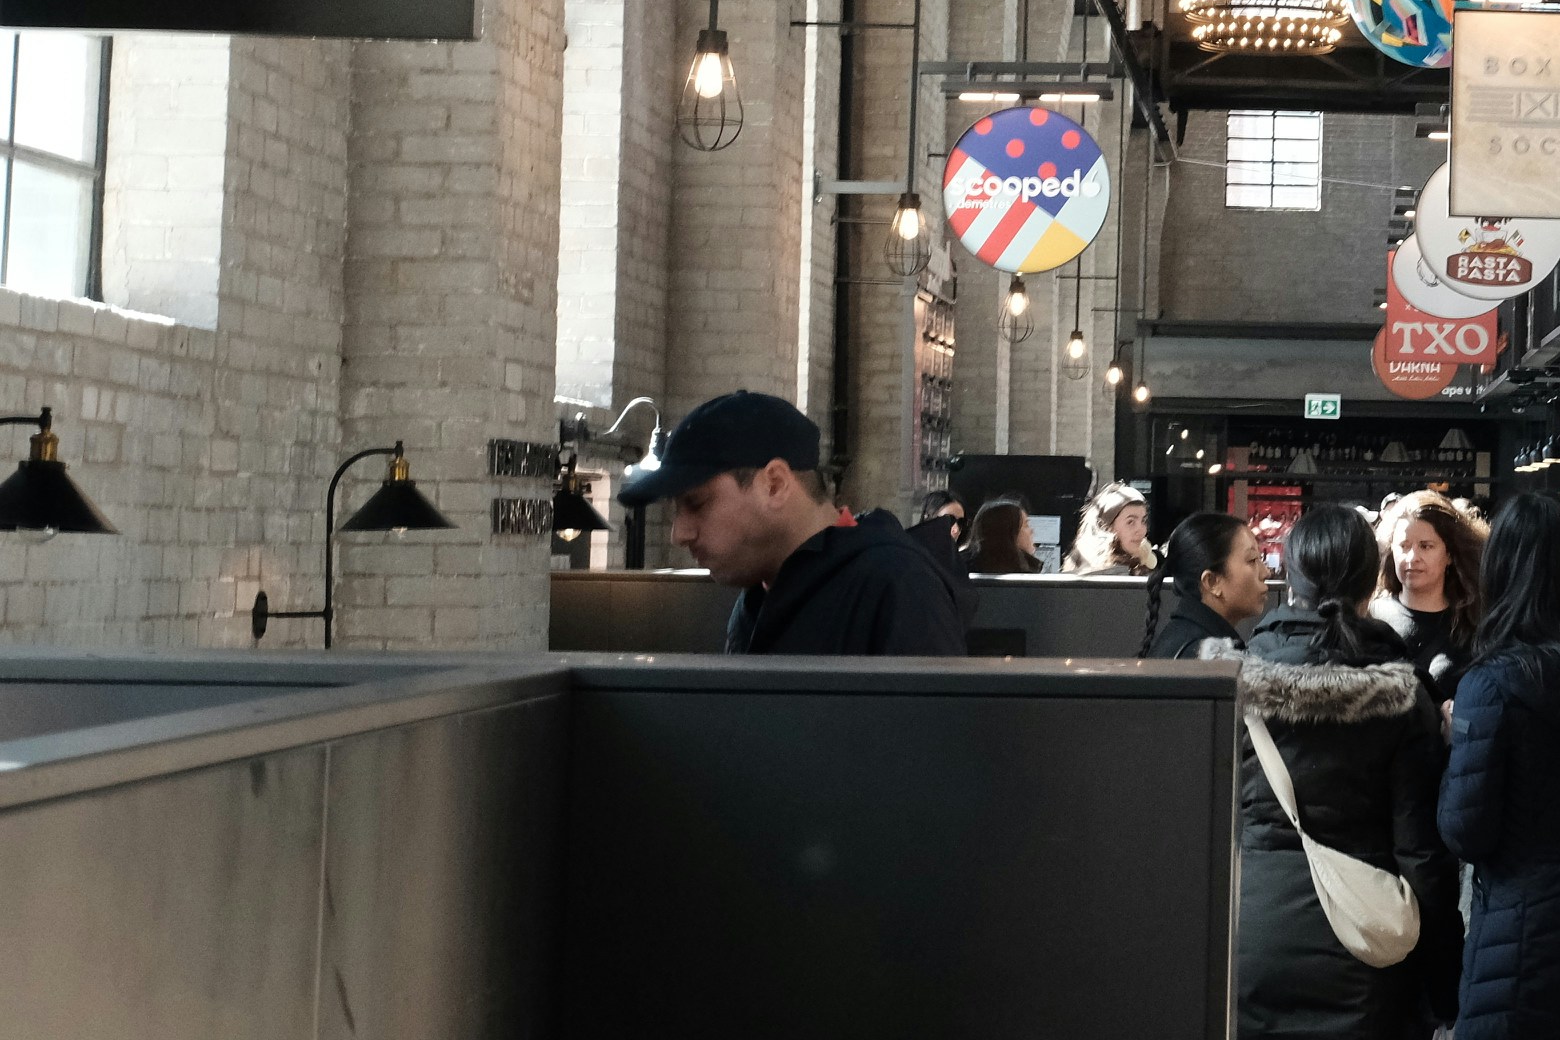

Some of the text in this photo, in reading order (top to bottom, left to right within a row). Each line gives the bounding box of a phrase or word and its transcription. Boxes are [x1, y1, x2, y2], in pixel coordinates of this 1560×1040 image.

[949, 168, 1082, 203] scooped
[1457, 267, 1521, 283] PASTA
[1458, 256, 1521, 272] RASTA
[1392, 320, 1490, 356] TXO
